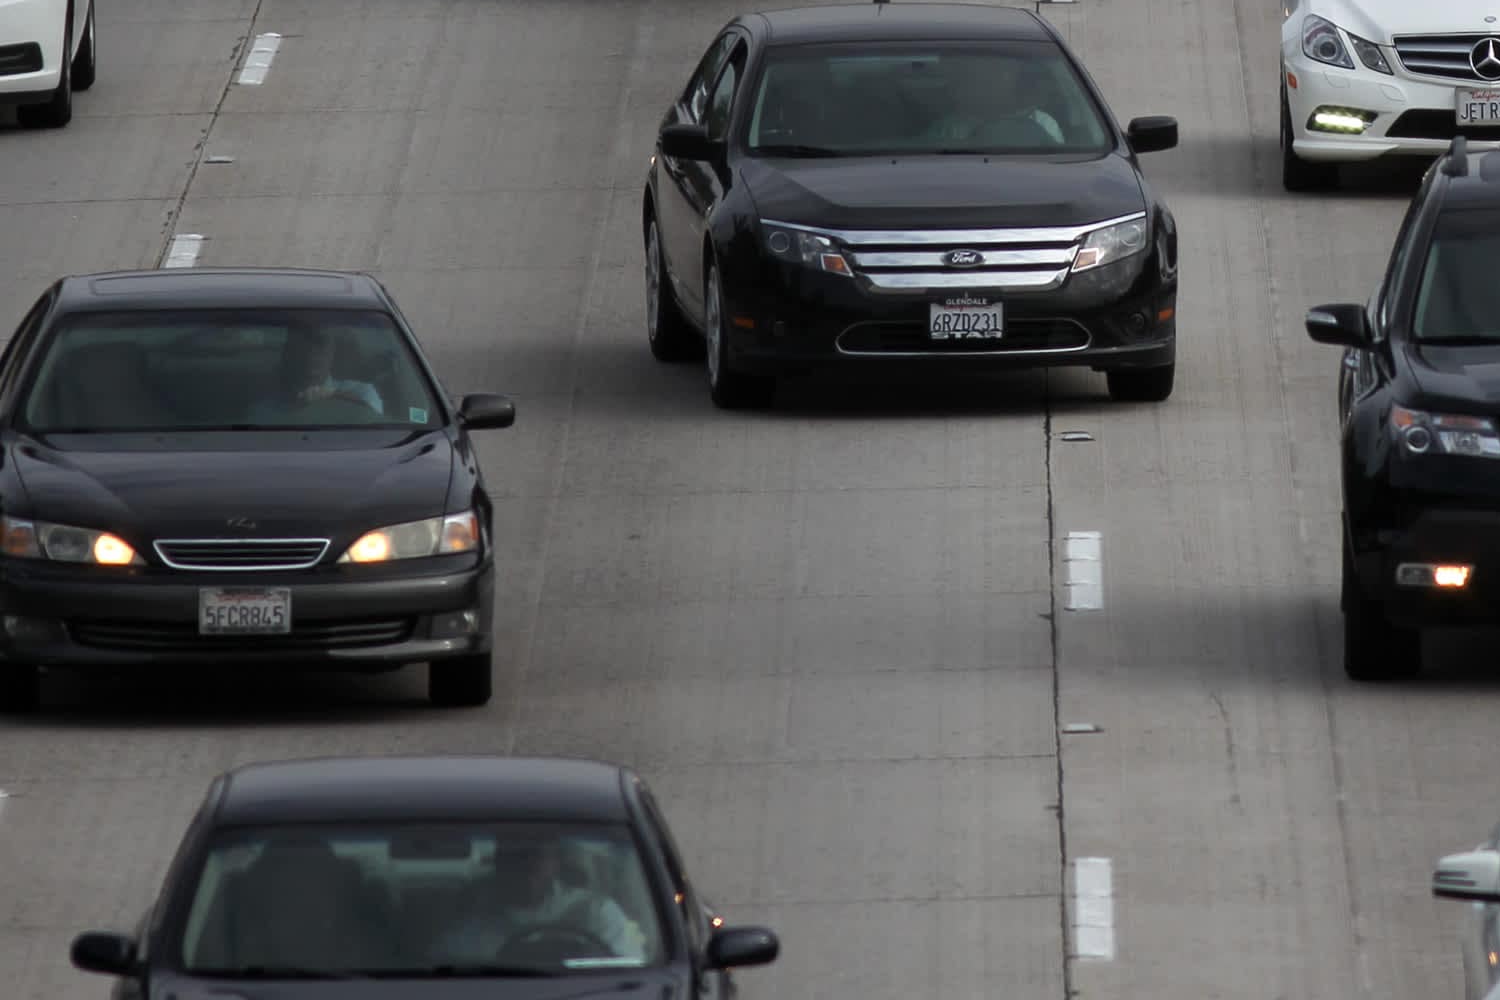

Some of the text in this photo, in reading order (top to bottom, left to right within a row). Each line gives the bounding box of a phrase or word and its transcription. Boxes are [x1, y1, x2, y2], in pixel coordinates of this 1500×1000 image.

[951, 252, 977, 263] Ford
[932, 313, 999, 332] 6RZD231
[206, 605, 284, 625] 5FCR845
